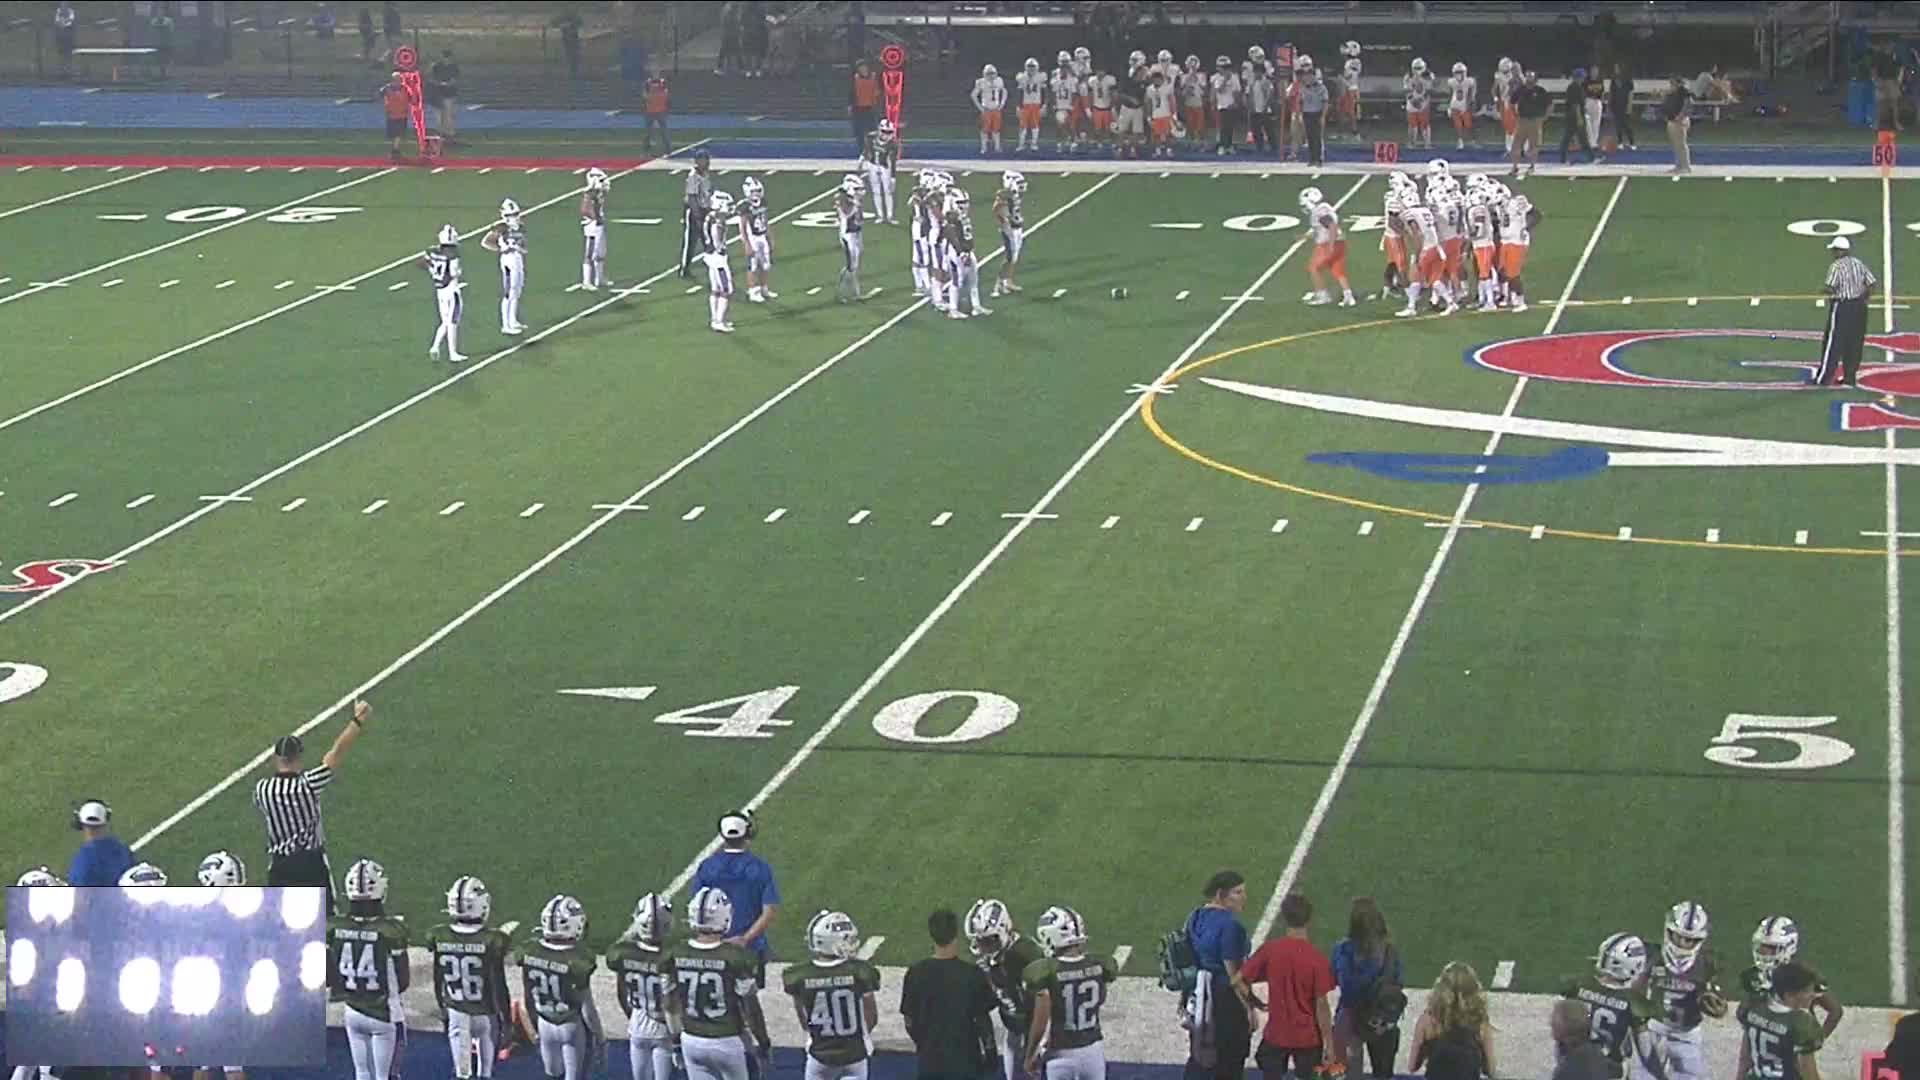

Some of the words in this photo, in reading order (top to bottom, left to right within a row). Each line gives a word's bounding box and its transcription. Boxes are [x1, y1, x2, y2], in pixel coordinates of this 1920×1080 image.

[1377, 143, 1397, 162] 40
[339, 942, 379, 990] 44
[440, 954, 484, 1001] 26
[528, 970, 569, 1014] 21
[624, 972, 662, 1019] 30
[678, 970, 727, 1018] 73
[811, 990, 857, 1037] 40
[1062, 980, 1100, 1031] 12
[1749, 1027, 1784, 1078] 15
